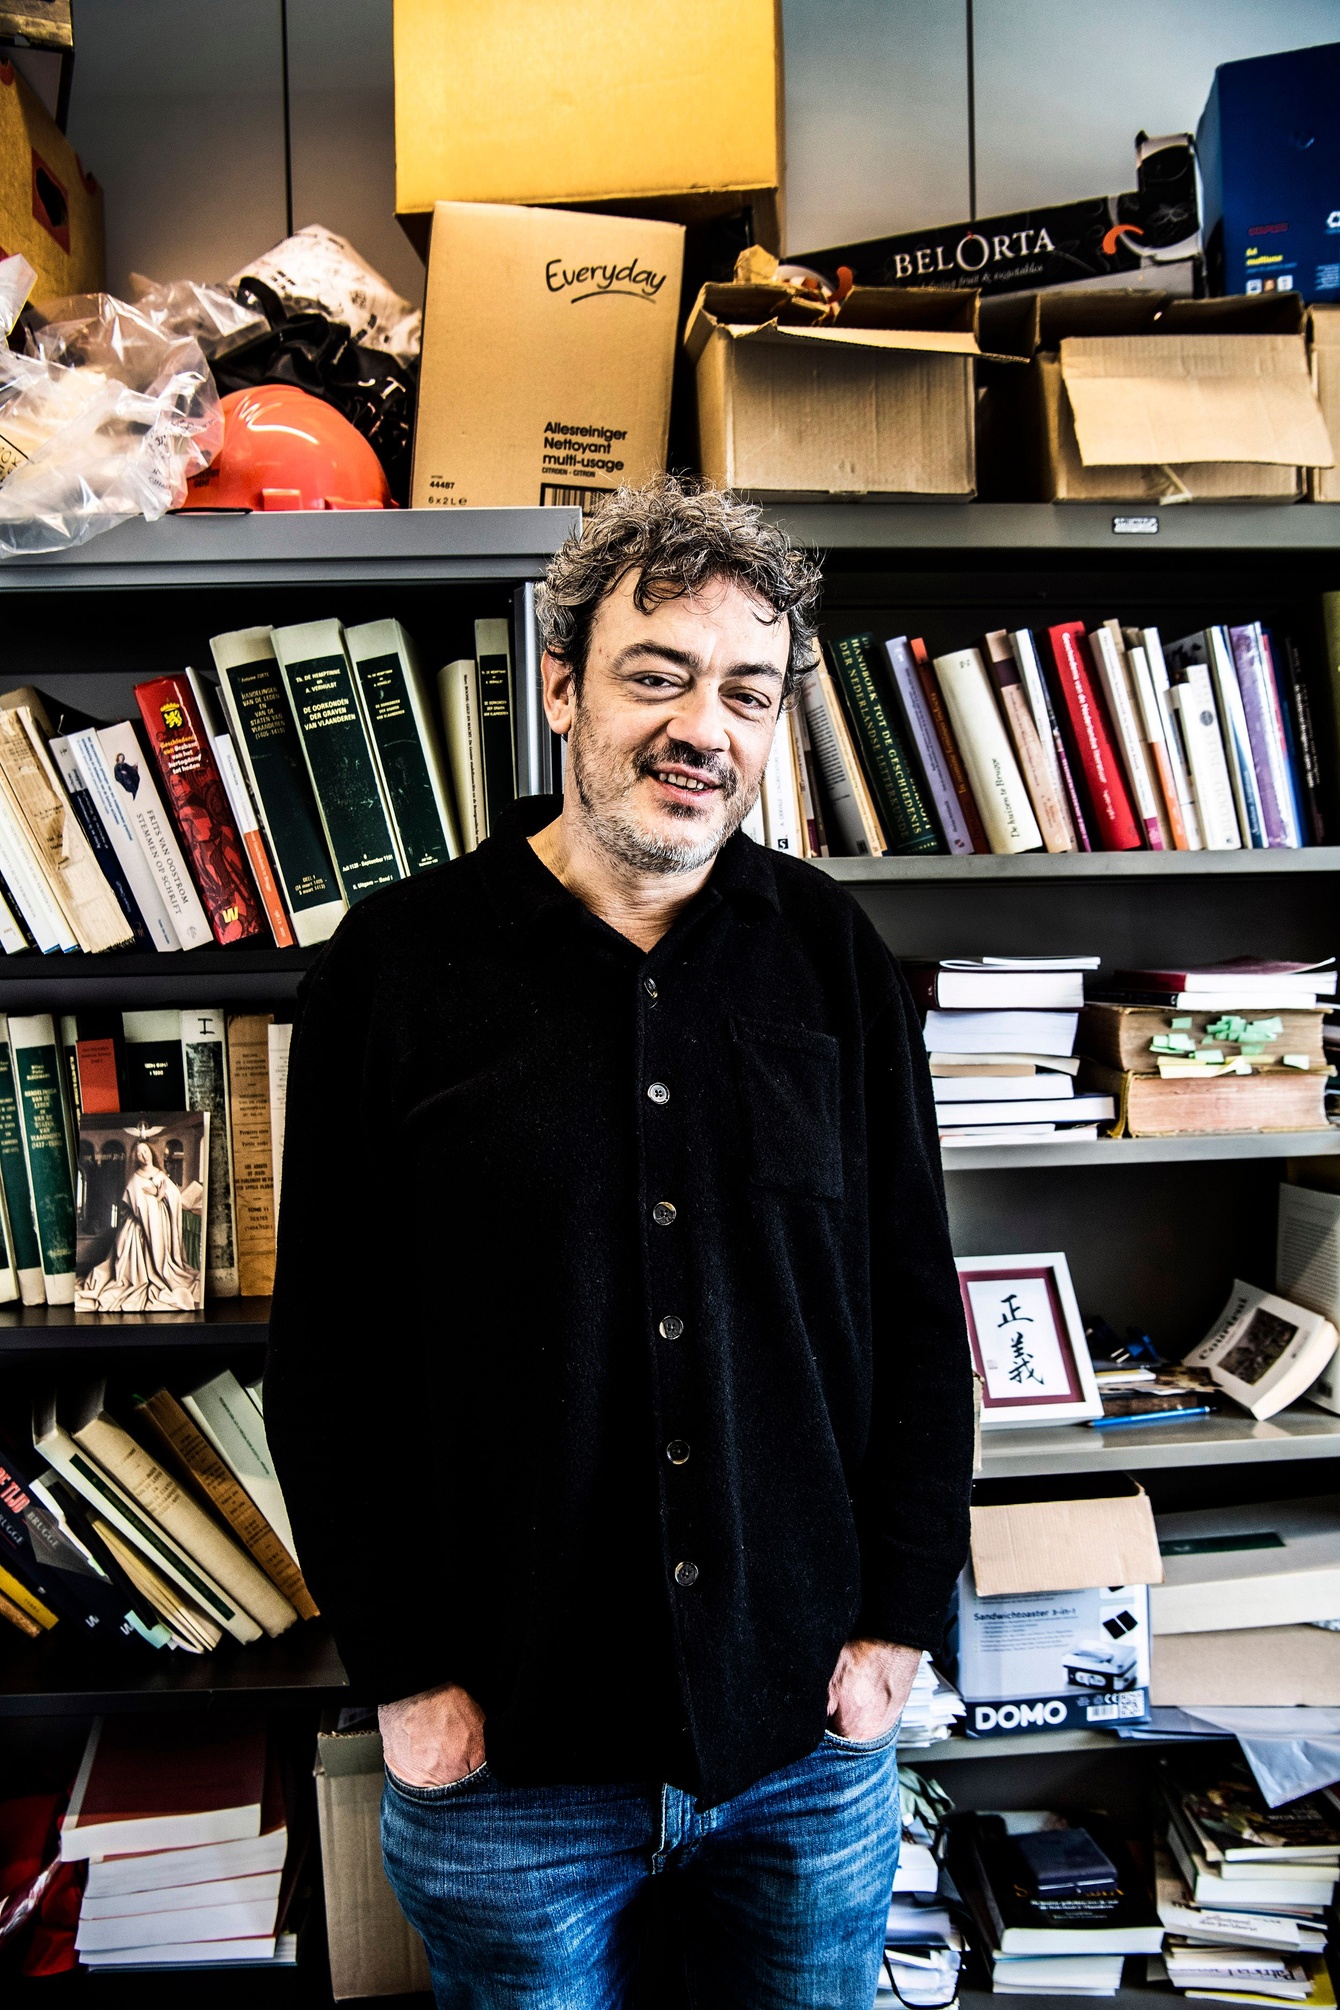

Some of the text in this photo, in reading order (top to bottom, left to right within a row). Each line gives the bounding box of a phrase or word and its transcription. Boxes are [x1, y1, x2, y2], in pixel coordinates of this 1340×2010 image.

[894, 228, 1056, 279] BELORTA
[546, 258, 666, 296] Everyday
[544, 421, 628, 442] Allesreiniger
[544, 437, 611, 455] Nettoyant
[542, 454, 624, 472] multi-usage
[542, 467, 596, 478] CITROEN CITRON
[1061, 631, 1080, 680] Geschiedenis
[312, 669, 341, 679] HEMPTINNE
[241, 687, 278, 700] HANDELINGEN
[312, 682, 337, 692] VERHULST
[1073, 679, 1084, 694] van
[263, 694, 280, 702] LEDEN
[312, 698, 349, 712] OORKONDEN
[1076, 693, 1087, 704] de
[250, 713, 283, 727] STATEN VAN
[255, 710, 266, 718] VAN
[304, 713, 356, 731] VAN VLAANDEREN
[310, 707, 347, 721] DER GRAVEN
[251, 720, 285, 734] VLAANDEREN
[1079, 703, 1098, 750] Nederlandse
[837, 641, 909, 838] DER NEDERLANDSE LETTERKUNDE
[850, 638, 921, 834] HANDBOEK TOT DE GESCHIEDENIS
[1091, 749, 1107, 784] literatuur
[989, 757, 1019, 838] De huizen te Brugge
[137, 813, 159, 858] STEMMEN
[156, 860, 165, 873] OP
[162, 876, 182, 914] SCHRIFT
[147, 809, 189, 904] FRITS VAN OOSTROM
[997, 1294, 1045, 1385] 正義
[0, 1481, 30, 1513] TIJD
[27, 1511, 59, 1548] BRUGGE
[974, 1609, 1049, 1621] Sandwichtoaster
[975, 1700, 1067, 1730] DOMO
